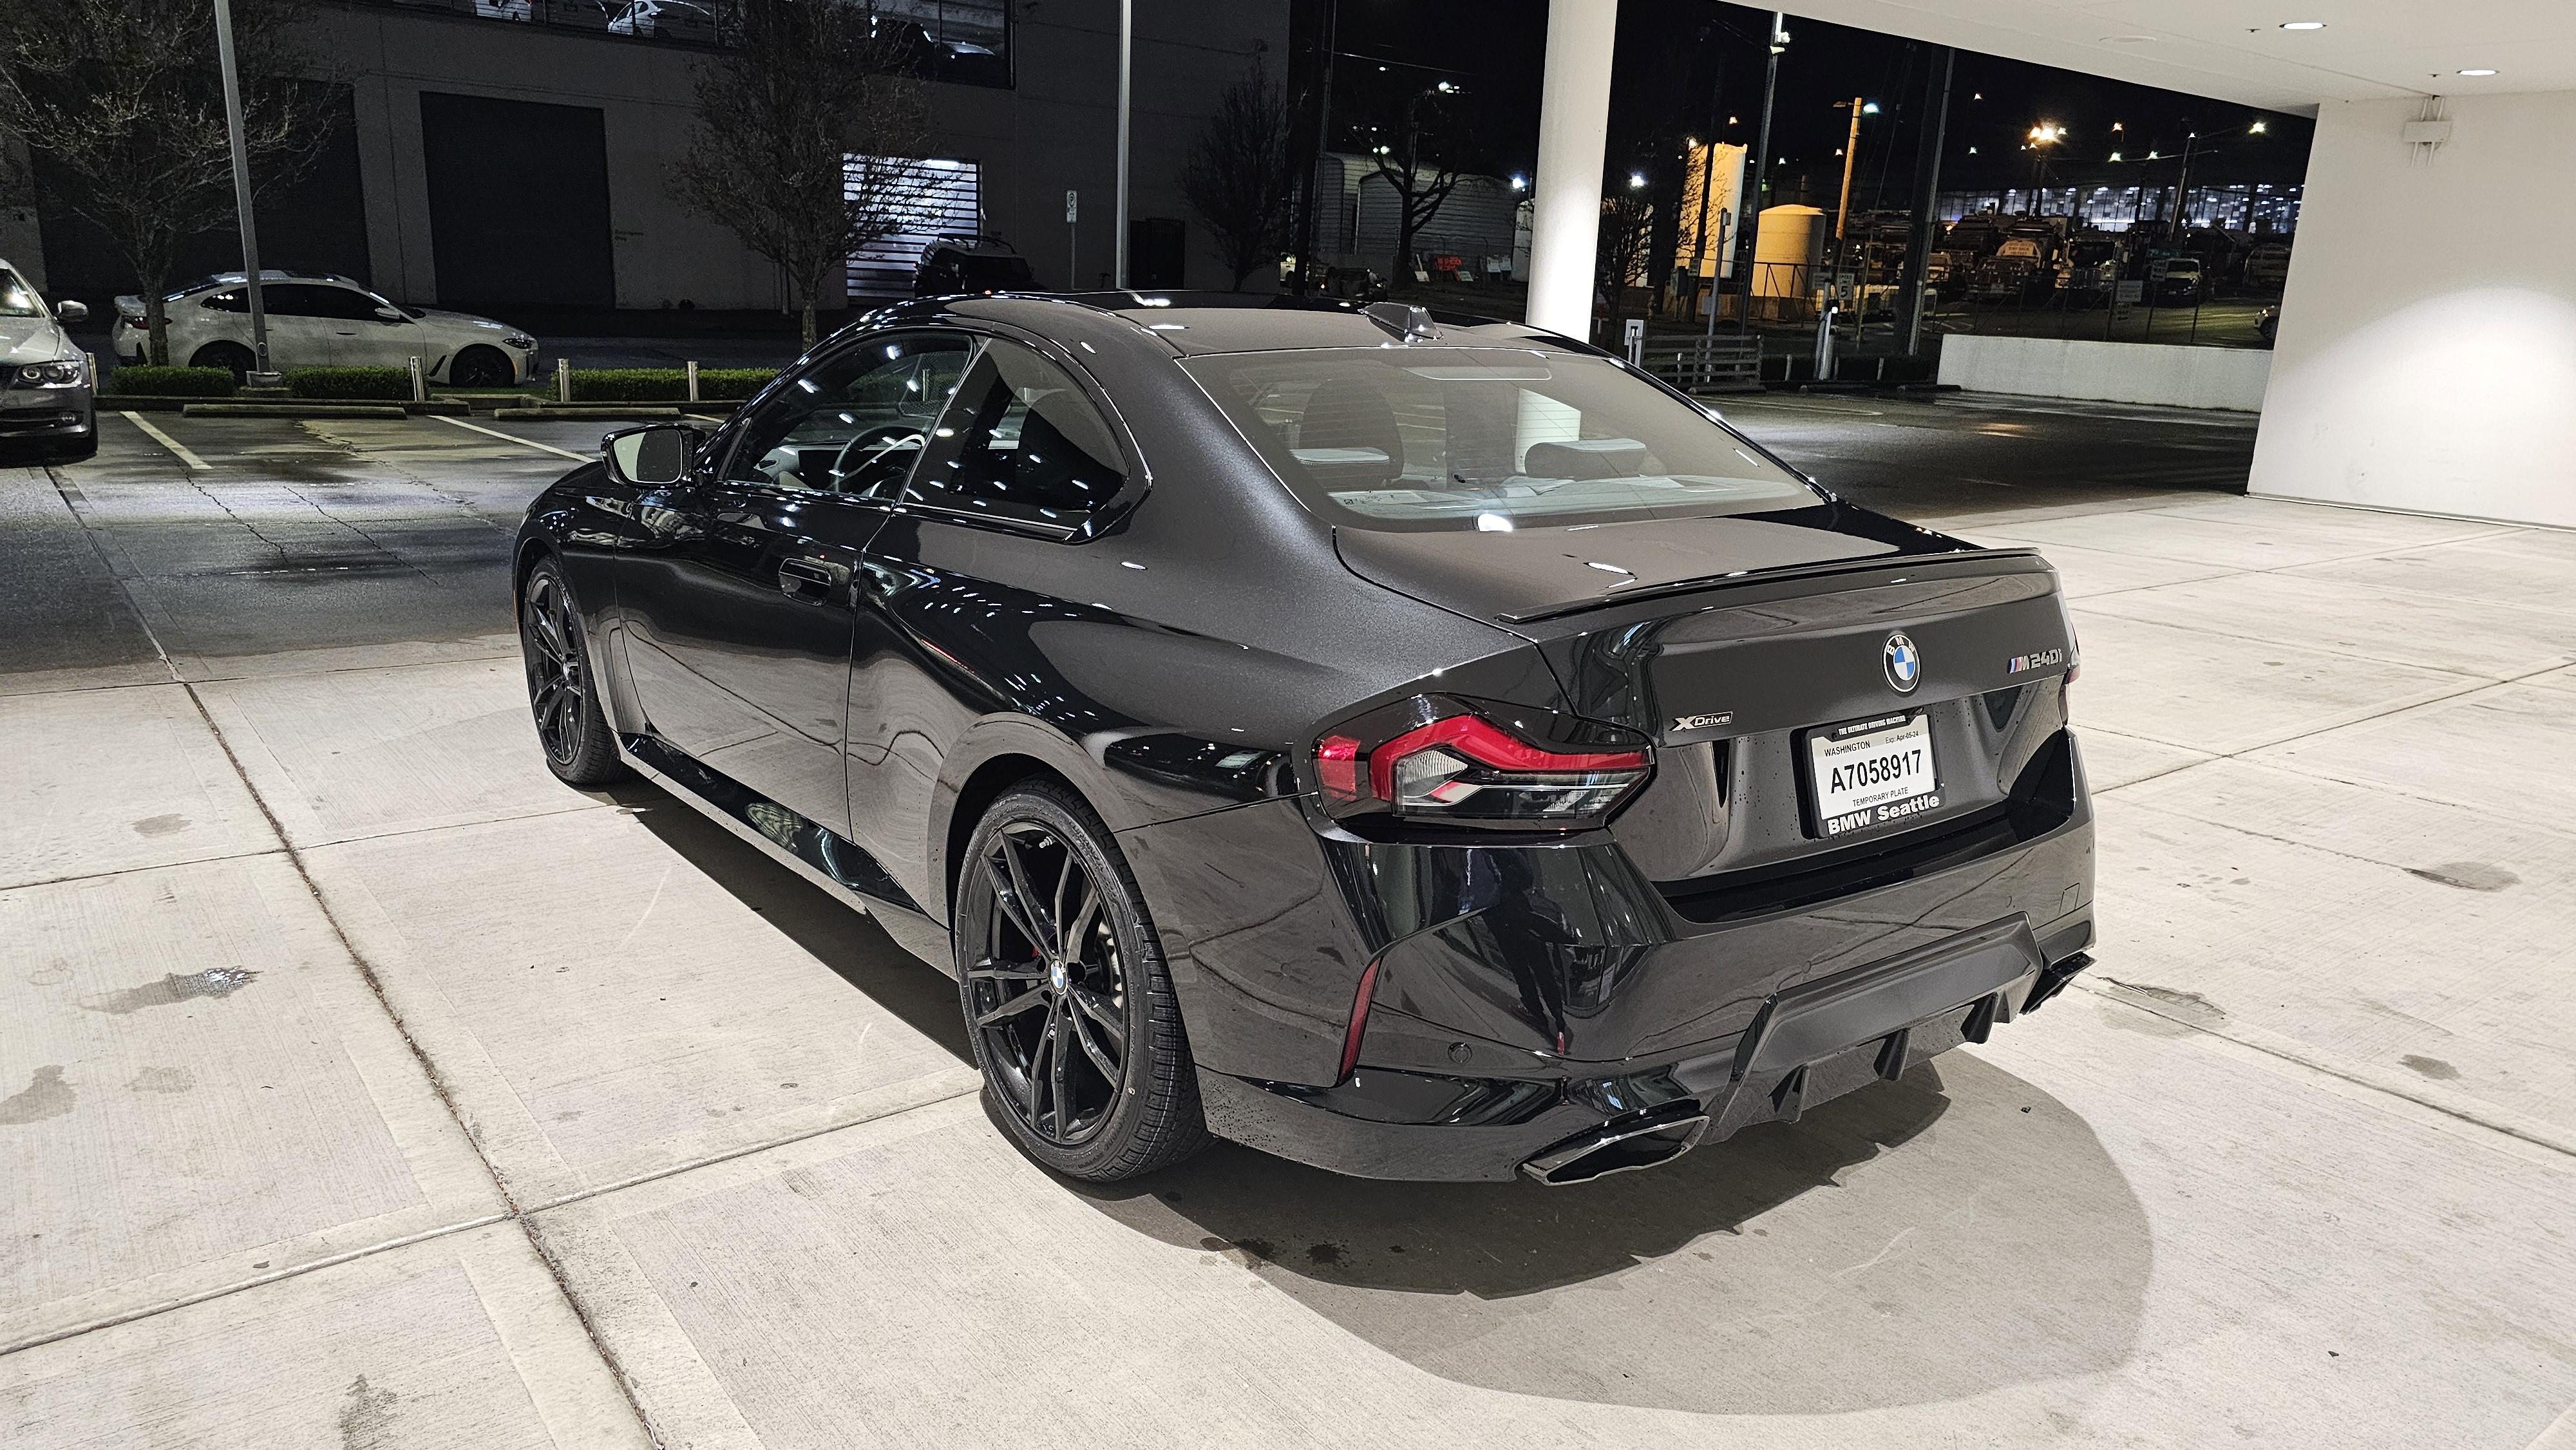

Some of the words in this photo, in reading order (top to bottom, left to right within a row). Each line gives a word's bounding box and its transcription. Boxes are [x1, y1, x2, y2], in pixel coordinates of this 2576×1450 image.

[1841, 285, 1848, 297] 5
[1887, 636, 1915, 655] BMW
[2010, 648, 2062, 673] M240i
[1897, 730, 1919, 742] Apr-05-24
[1824, 740, 1871, 757] WASHINGTON
[1831, 749, 1921, 794] A7058917
[1852, 791, 1889, 807] TEMPORARY
[1891, 786, 1909, 797] PLATE
[1827, 809, 1871, 835] BMW
[1877, 794, 1940, 822] Seattle
